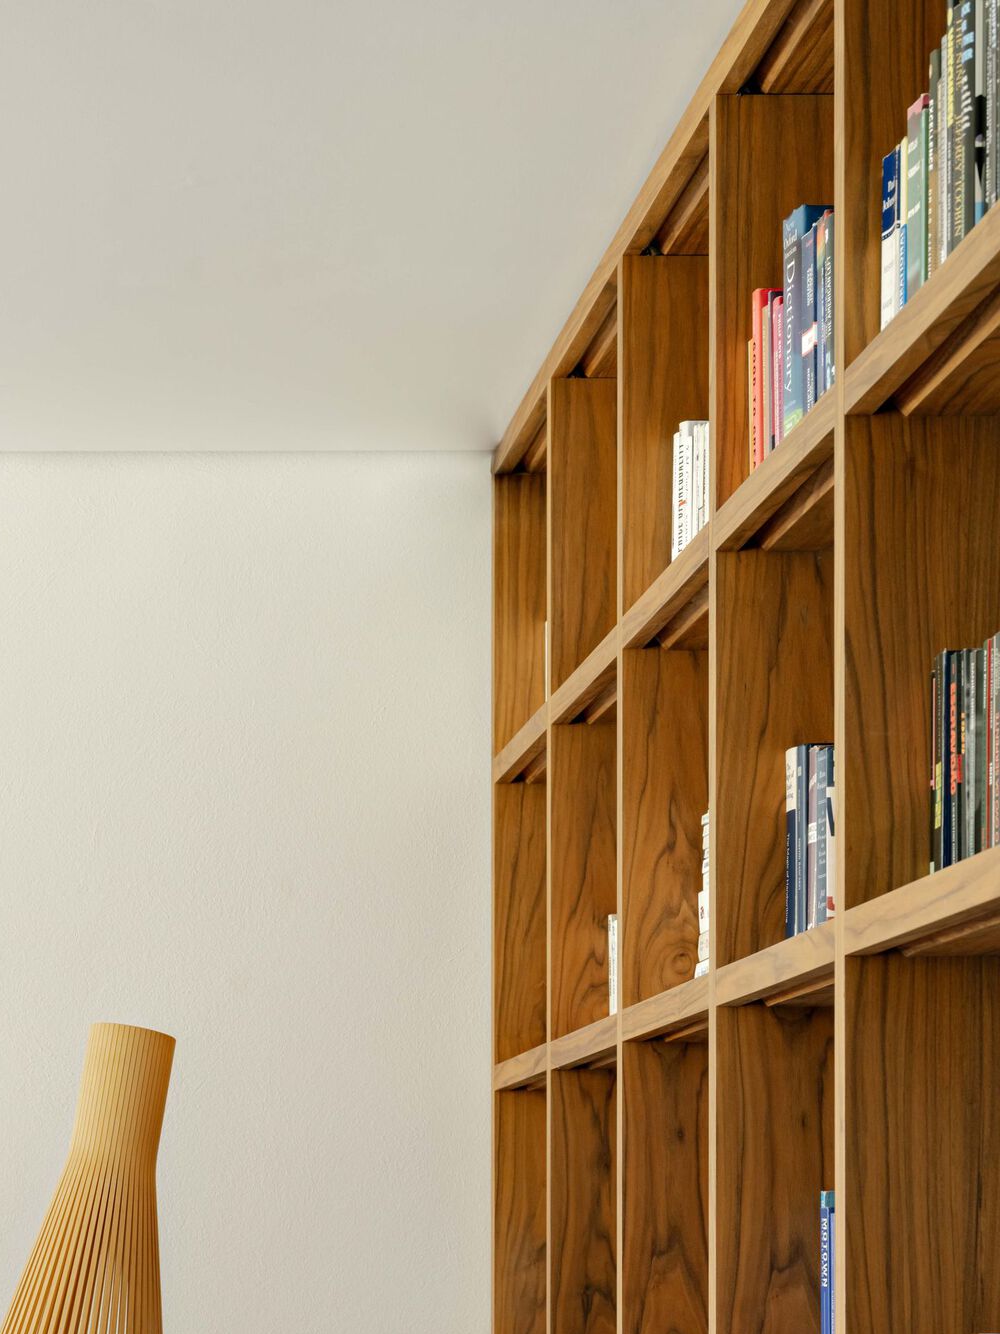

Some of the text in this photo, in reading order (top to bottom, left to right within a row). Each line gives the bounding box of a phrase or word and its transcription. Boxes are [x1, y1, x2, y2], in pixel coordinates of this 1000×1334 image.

[954, 114, 963, 172] JEFFREY
[955, 176, 963, 238] TOOBIN
[785, 259, 796, 393] Dictionary
[753, 396, 757, 417] TO
